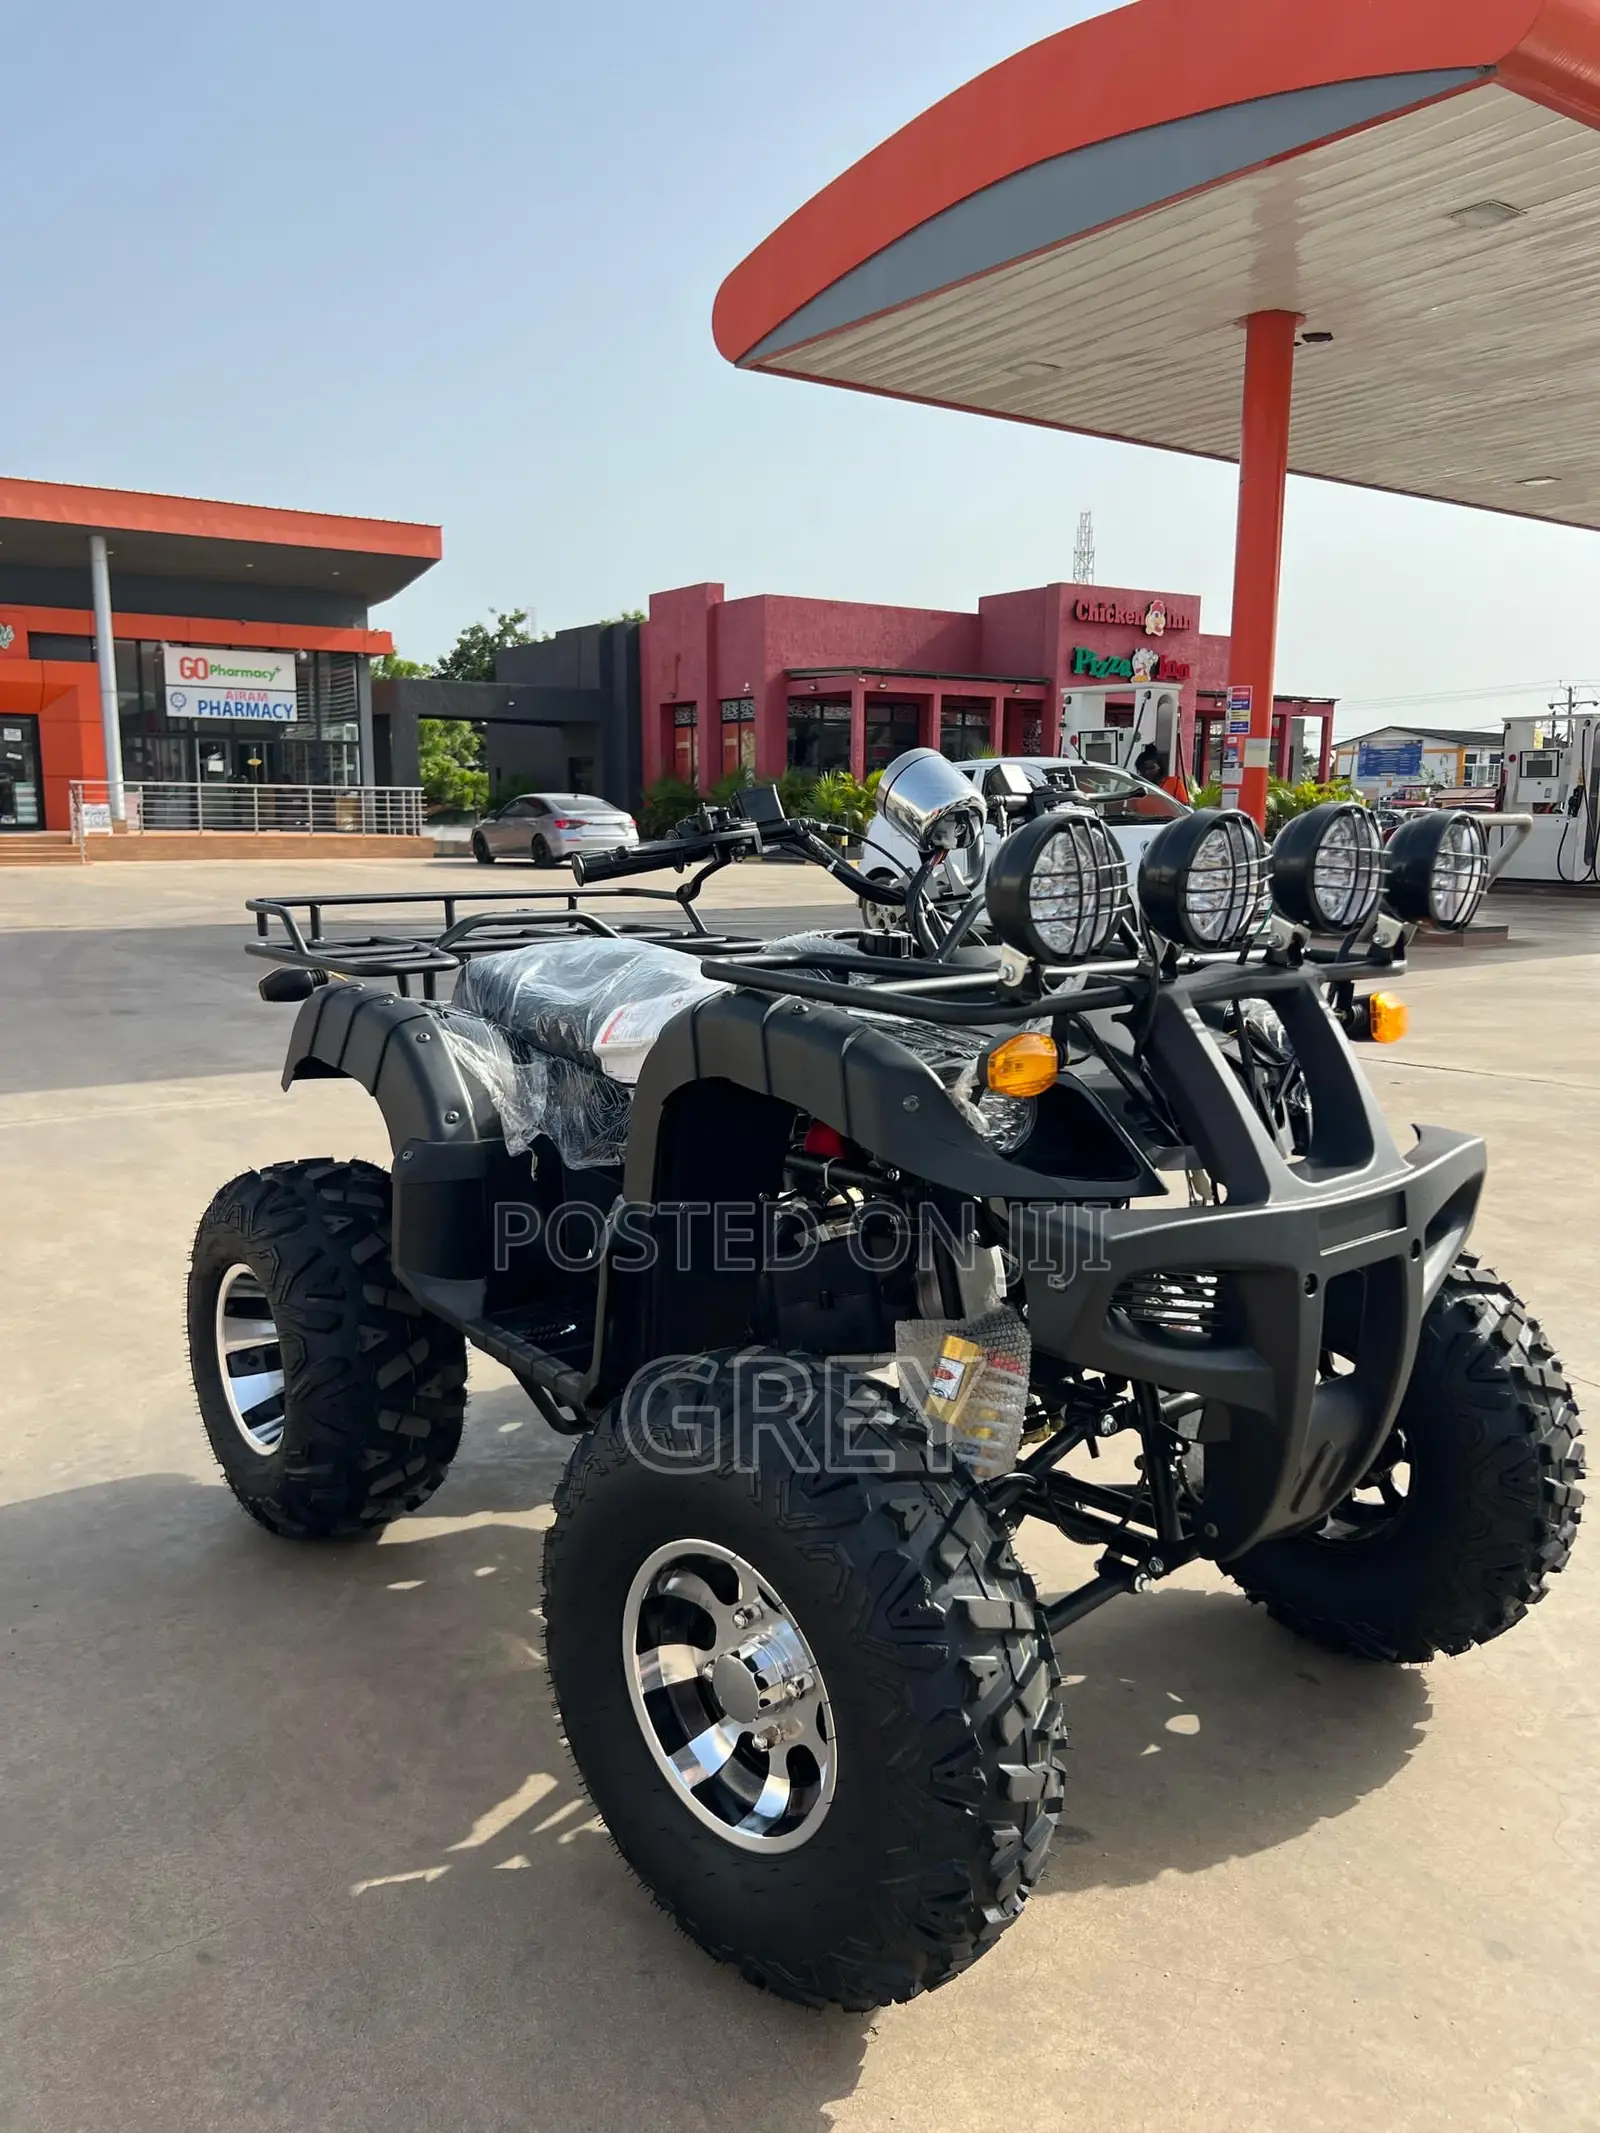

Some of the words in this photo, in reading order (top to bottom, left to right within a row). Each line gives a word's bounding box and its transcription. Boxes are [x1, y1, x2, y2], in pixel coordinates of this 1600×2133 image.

[1074, 600, 1145, 626] Chicken
[1165, 607, 1192, 630] Inn
[179, 656, 209, 680] GO
[1072, 646, 1133, 678] Pizza
[225, 690, 269, 701] AIRAM
[198, 701, 293, 719] PHARMACY
